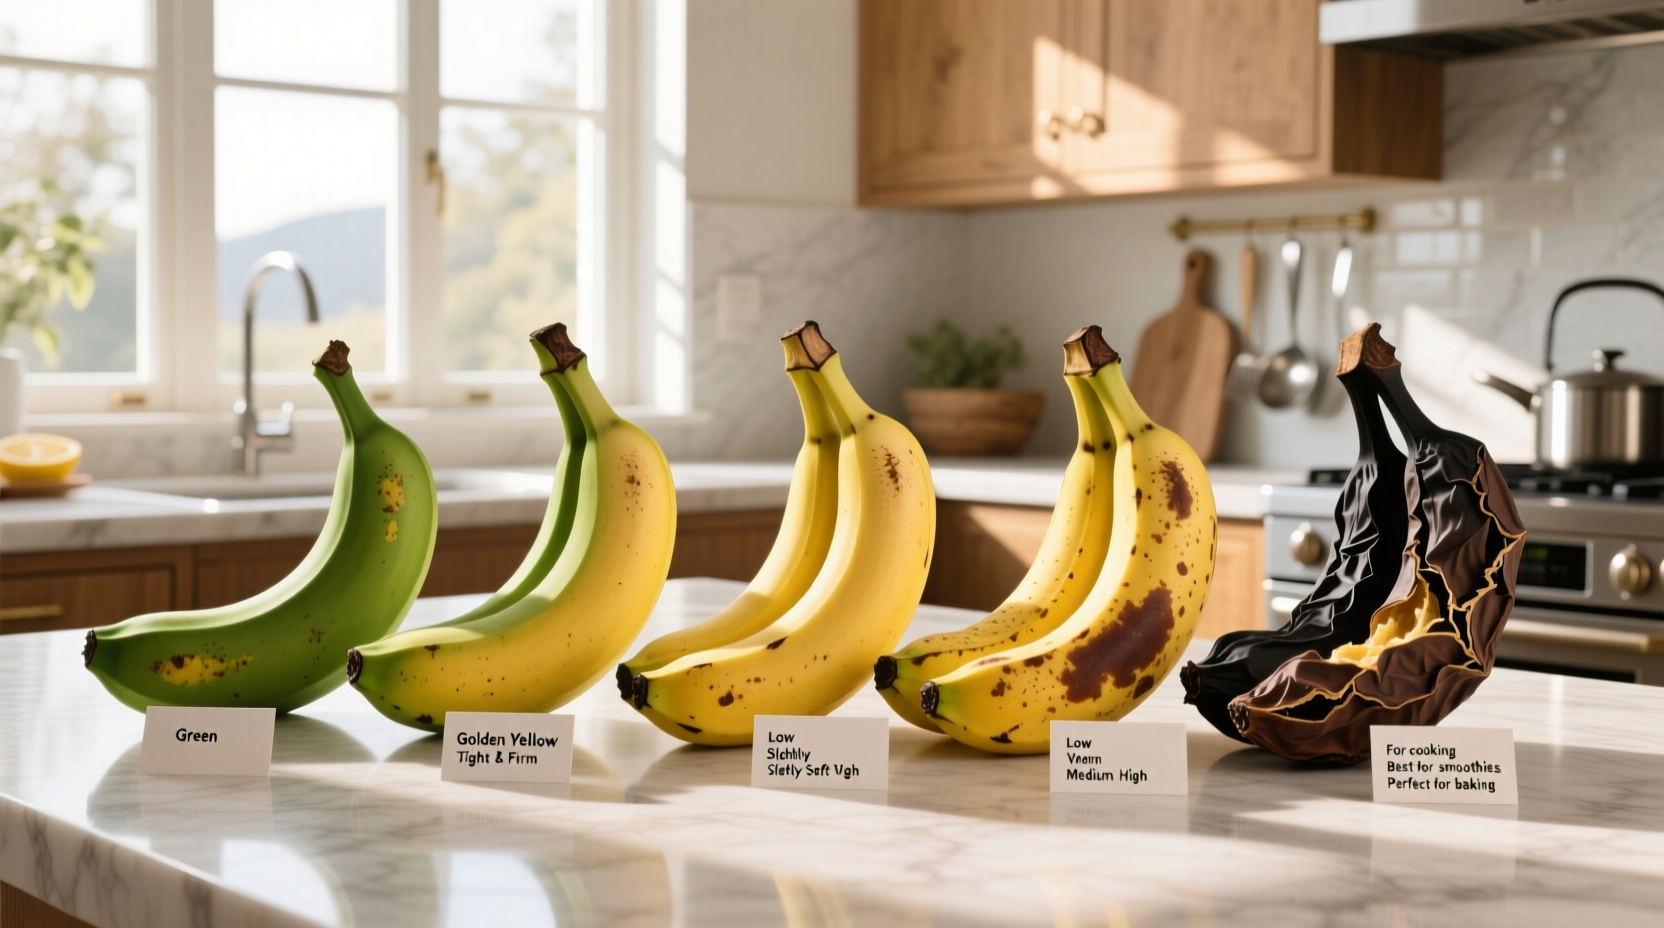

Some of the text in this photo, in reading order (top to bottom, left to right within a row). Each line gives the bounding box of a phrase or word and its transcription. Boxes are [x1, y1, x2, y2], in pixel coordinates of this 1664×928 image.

[176, 728, 217, 742] Green
[457, 731, 559, 747] Golden Yellow
[768, 731, 795, 743] Low
[1066, 737, 1092, 748] Low
[495, 751, 504, 763] &
[508, 752, 538, 764] Firm
[1386, 743, 1456, 759] For cooking
[1387, 761, 1413, 772] Best
[1438, 761, 1502, 774] smoothies
[1119, 768, 1147, 784] High
[1387, 777, 1495, 793] Perfect for baking
